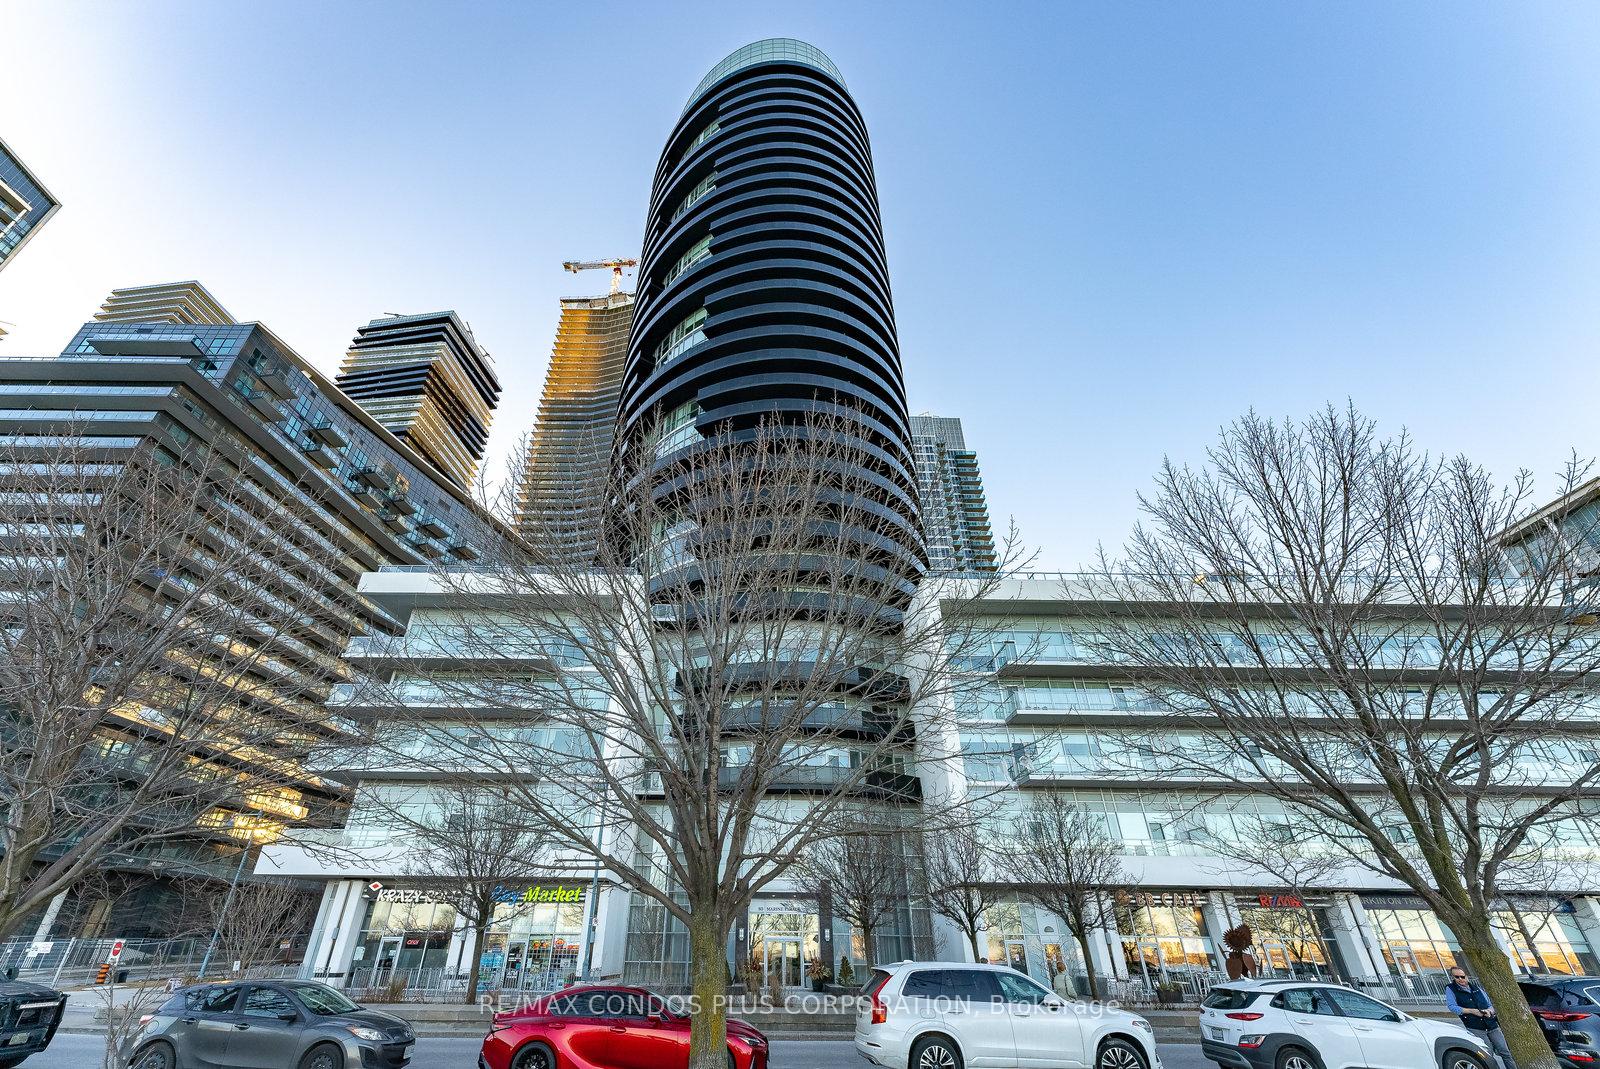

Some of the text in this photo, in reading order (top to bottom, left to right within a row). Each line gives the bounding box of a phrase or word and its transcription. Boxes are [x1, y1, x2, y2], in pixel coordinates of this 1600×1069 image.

[377, 889, 422, 903] KRAZY
[523, 884, 582, 902] Market
[1361, 896, 1423, 905] RKIN ON THE
